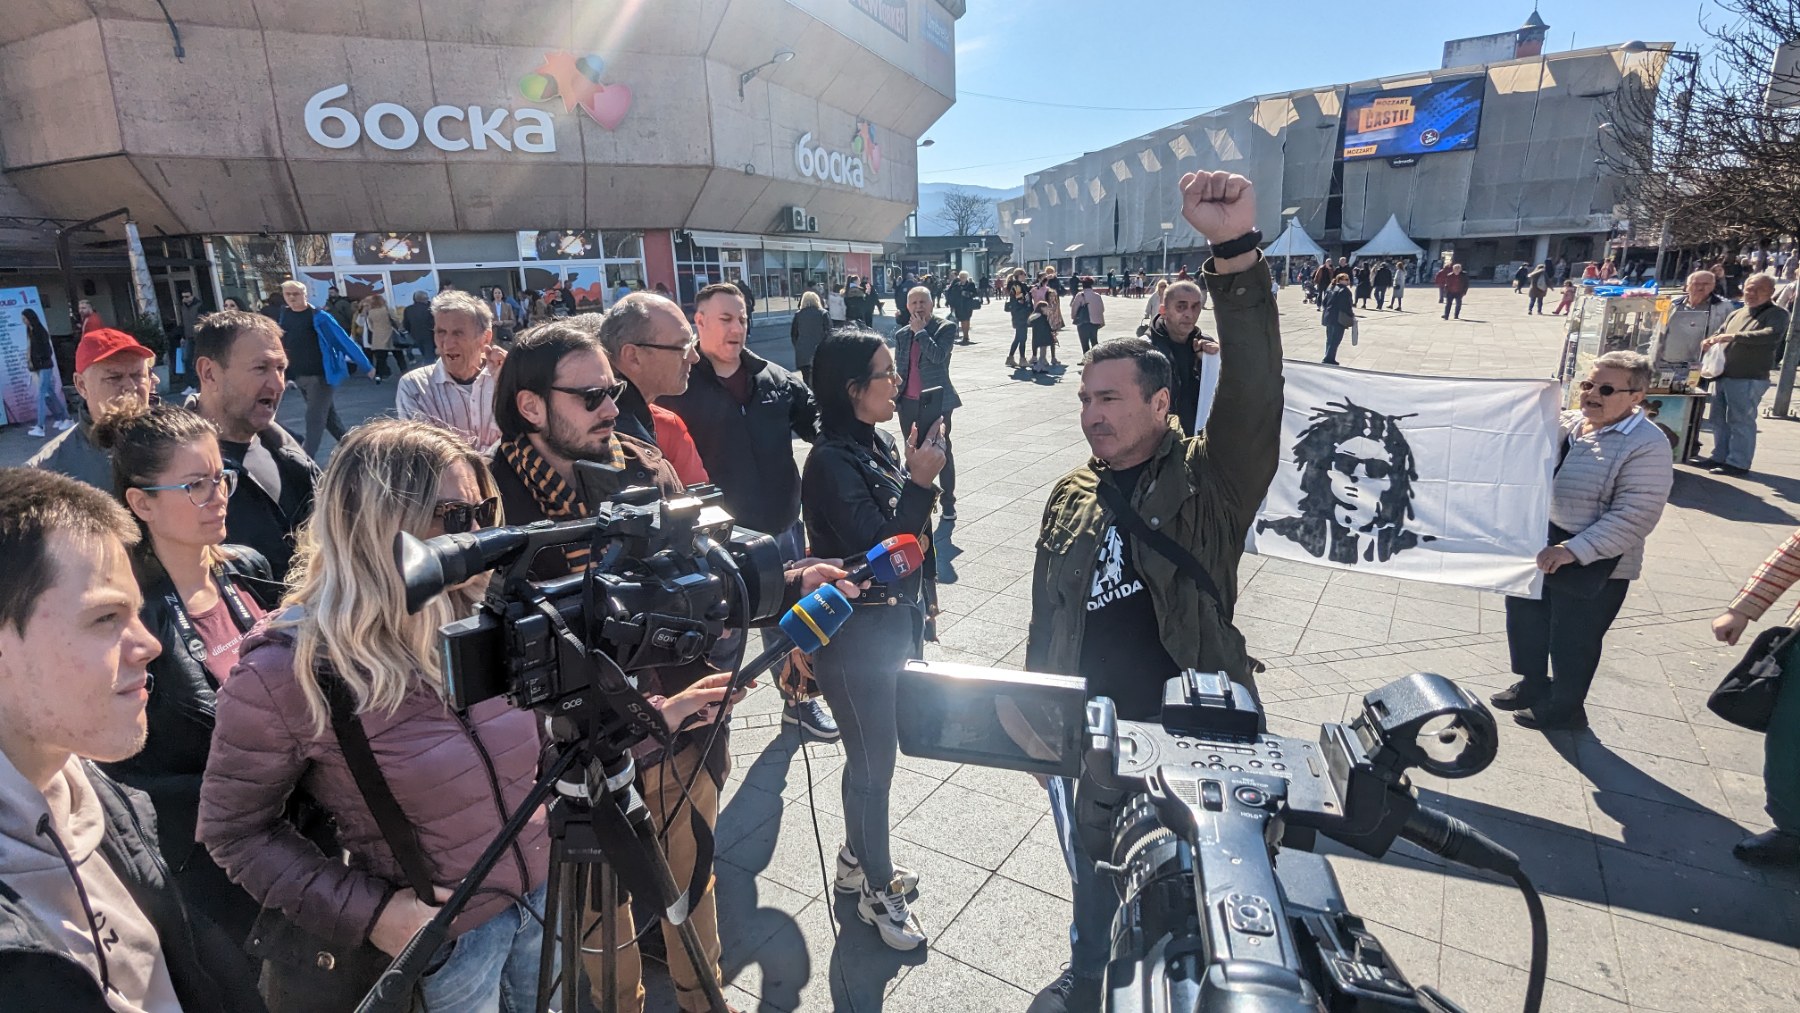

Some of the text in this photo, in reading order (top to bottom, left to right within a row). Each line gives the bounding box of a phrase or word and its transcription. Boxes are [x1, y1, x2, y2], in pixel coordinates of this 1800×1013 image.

[304, 84, 556, 153] боска
[797, 131, 864, 188] боска
[1346, 147, 1373, 155] MOZZART
[813, 593, 836, 615] BHRT
[1086, 579, 1144, 611] DAVIDA
[211, 637, 239, 656] different
[562, 698, 584, 710] ace
